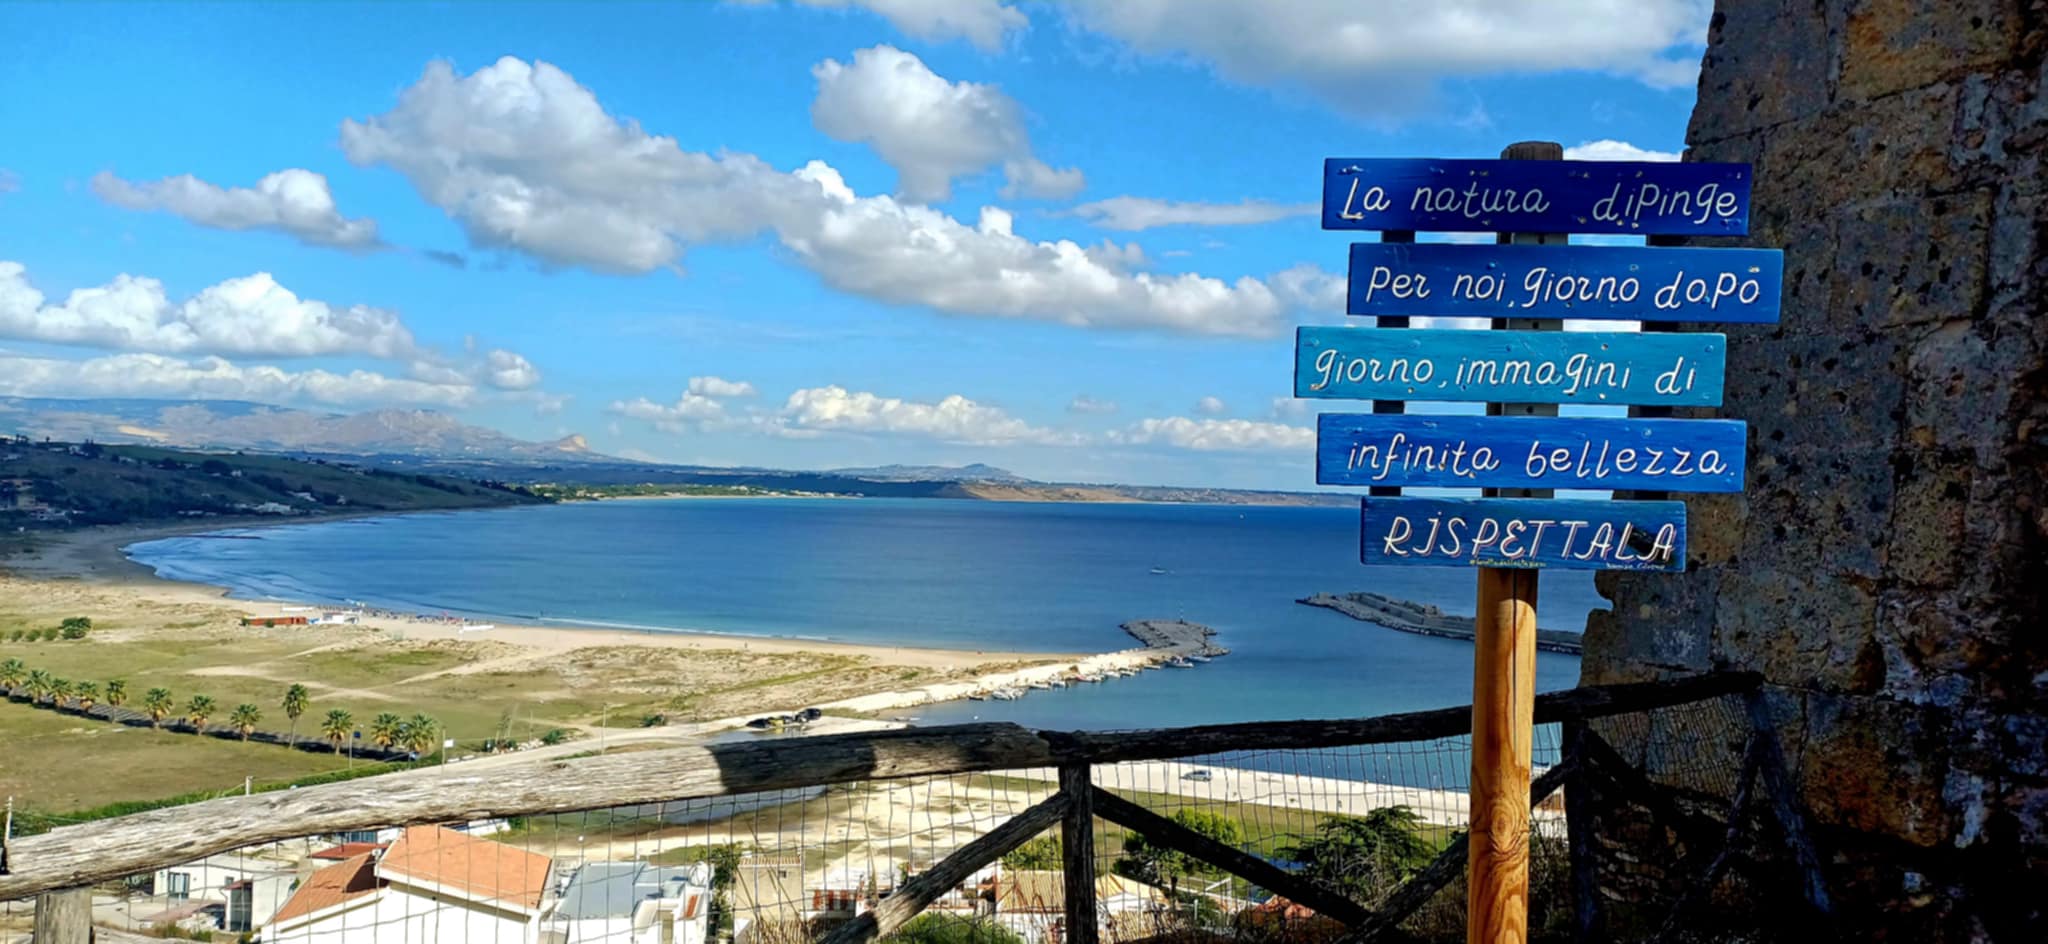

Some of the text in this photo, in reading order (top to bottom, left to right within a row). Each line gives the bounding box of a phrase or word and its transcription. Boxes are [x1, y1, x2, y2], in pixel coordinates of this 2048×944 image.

[1340, 177, 1738, 224] La natura dipinge
[1521, 267, 1640, 308] giorno
[1654, 271, 1760, 309] dopo
[1310, 349, 1698, 394] giorno, immagini di
[1347, 433, 1735, 480] infinita bellezza.
[1383, 511, 1678, 562] RISPETTALA
